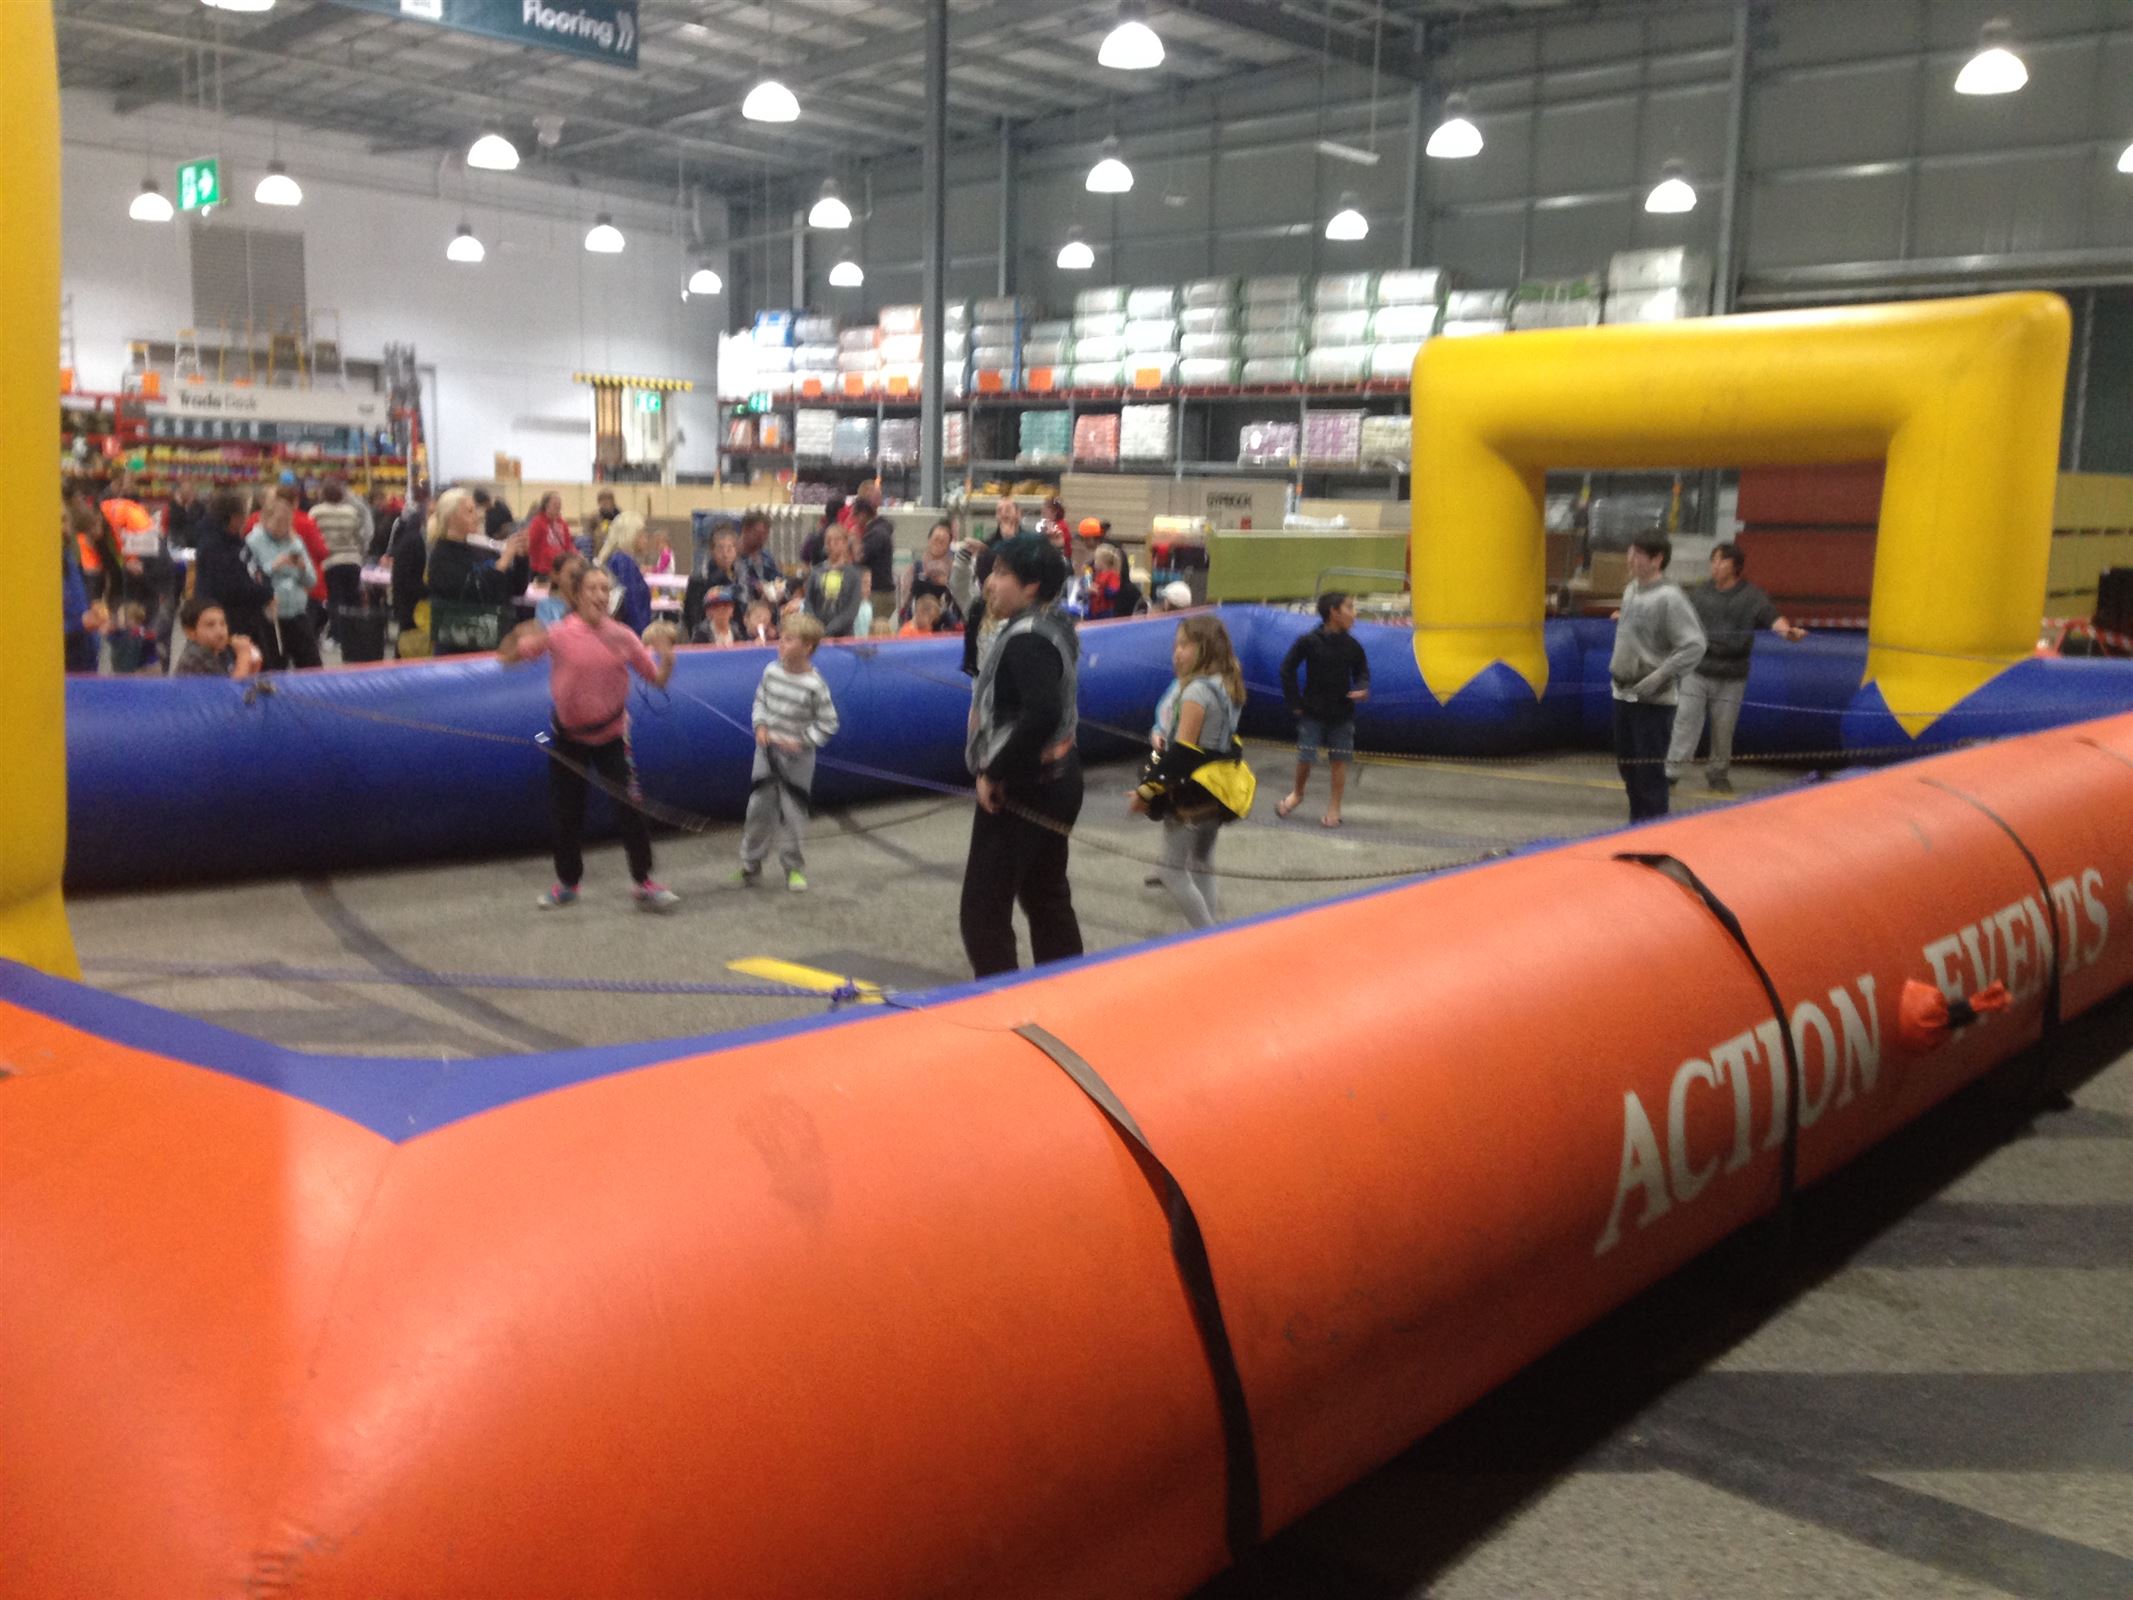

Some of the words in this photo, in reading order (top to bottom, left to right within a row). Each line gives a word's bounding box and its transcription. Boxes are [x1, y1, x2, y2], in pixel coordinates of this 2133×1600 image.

[522, 0, 614, 48] Flooring
[1594, 973, 1881, 1257] ACTION
[1923, 868, 2109, 1040] EVENTS
